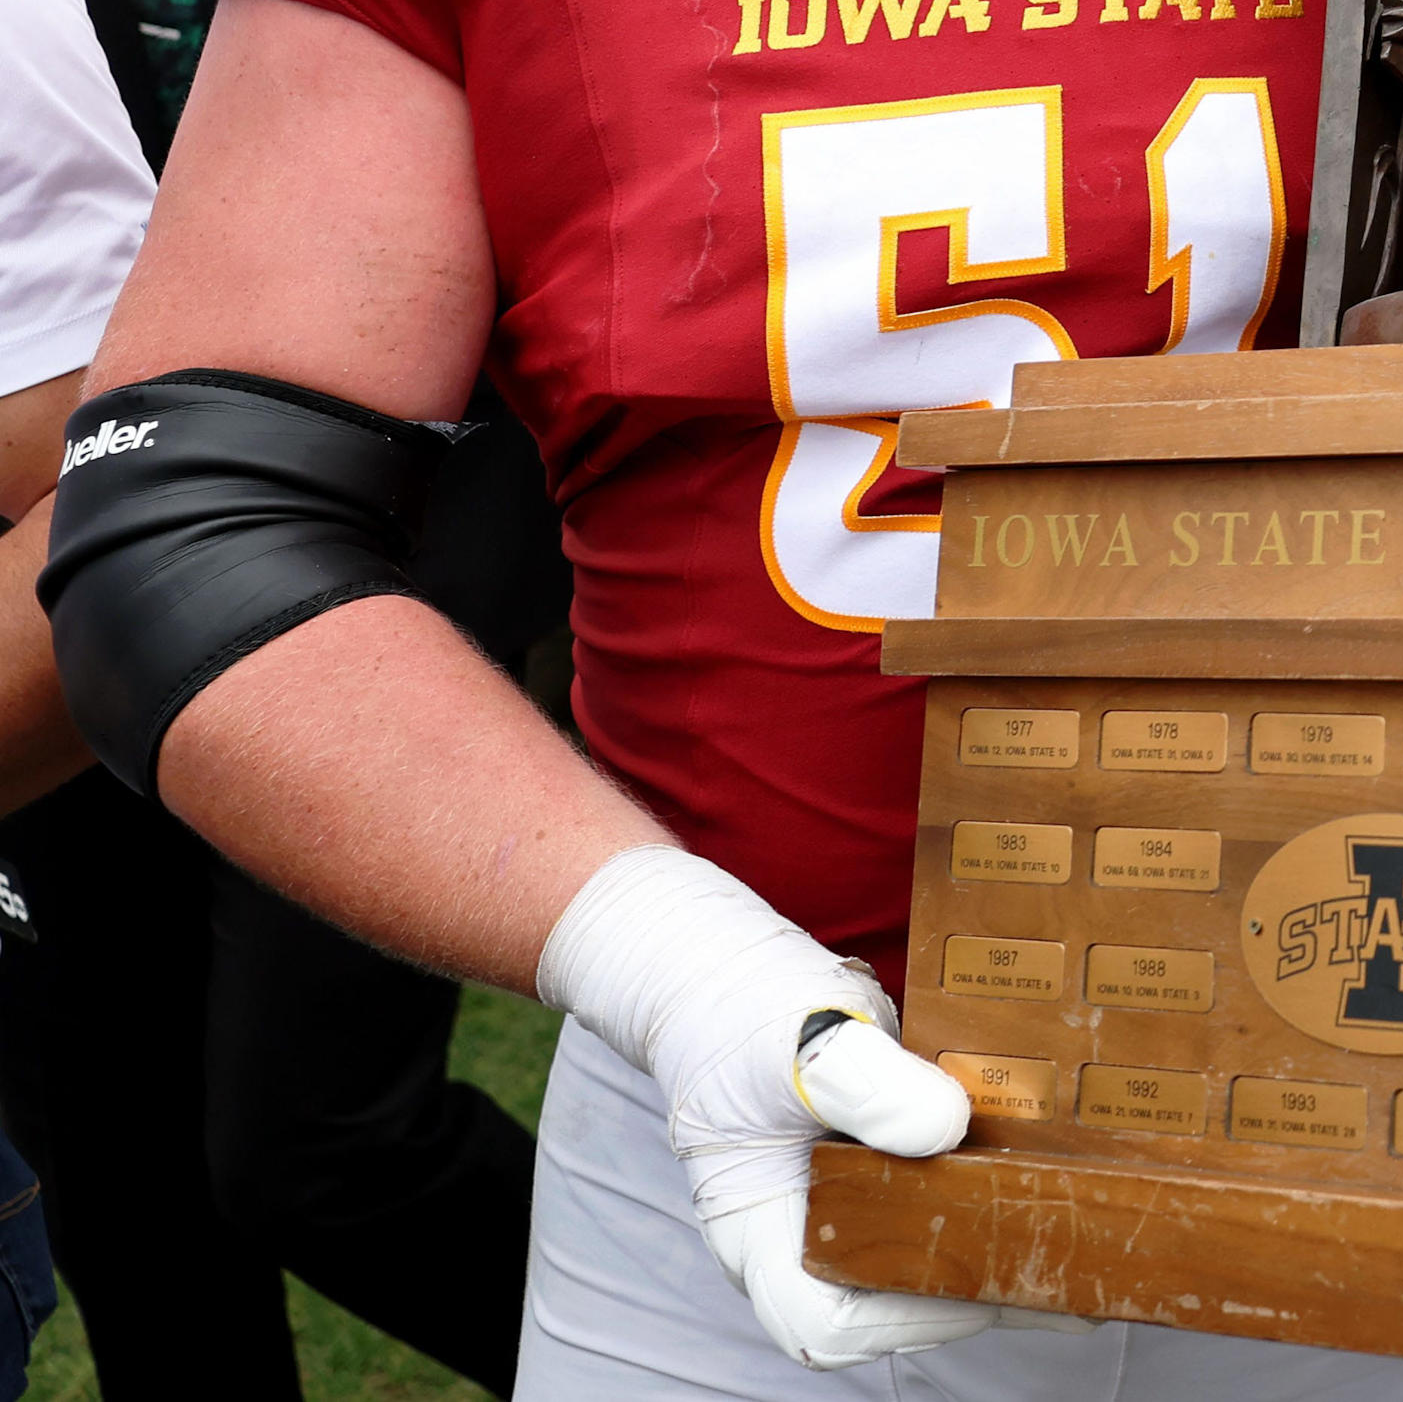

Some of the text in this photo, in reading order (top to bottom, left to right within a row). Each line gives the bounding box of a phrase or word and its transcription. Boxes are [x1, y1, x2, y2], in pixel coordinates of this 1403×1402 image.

[761, 77, 1287, 633] 51
[967, 513, 1139, 568] IOWA
[1170, 509, 1387, 568] STATE
[1006, 720, 1033, 736] 1977
[1149, 723, 1178, 738] 1978
[1301, 726, 1333, 743] 1979
[969, 746, 988, 755] IOWA
[1005, 748, 1026, 756] IOWA
[1030, 748, 1054, 757] STATE
[1111, 749, 1133, 758] IOWA
[1137, 750, 1163, 759] STATE
[1181, 751, 1203, 760] IOWA
[1259, 752, 1282, 762] IOWA
[1302, 753, 1325, 763] IOWA
[1330, 754, 1358, 764] STATE
[996, 835, 1026, 850] 1983
[1140, 841, 1172, 857] 1984
[961, 859, 981, 868] IOWA
[997, 861, 1018, 870] IOWA
[1022, 862, 1046, 872] STATE
[1103, 865, 1125, 875] IOWA
[1143, 867, 1165, 877] IOWA
[1169, 868, 1195, 878] STATE
[989, 950, 1017, 966] 1987
[1133, 960, 1166, 977] 1988
[952, 973, 972, 983] IOWA
[991, 976, 1012, 986] IOWA
[1016, 977, 1039, 988] STATE
[1097, 984, 1118, 994] IOWA
[1136, 987, 1158, 997] IOWA
[1163, 988, 1188, 998] STATE
[981, 1068, 1010, 1086] 1991
[1126, 1081, 1159, 1098] 1992
[981, 1097, 1001, 1106] IOWA
[1006, 1098, 1033, 1108] STATE
[1282, 1094, 1316, 1112] 1993
[1091, 1104, 1112, 1115] IOWA
[1130, 1107, 1152, 1118] IOWA
[1156, 1109, 1182, 1121] STATE
[1240, 1118, 1262, 1129] IOWA
[1282, 1121, 1305, 1132] IOWA
[1310, 1123, 1338, 1136] STATE
